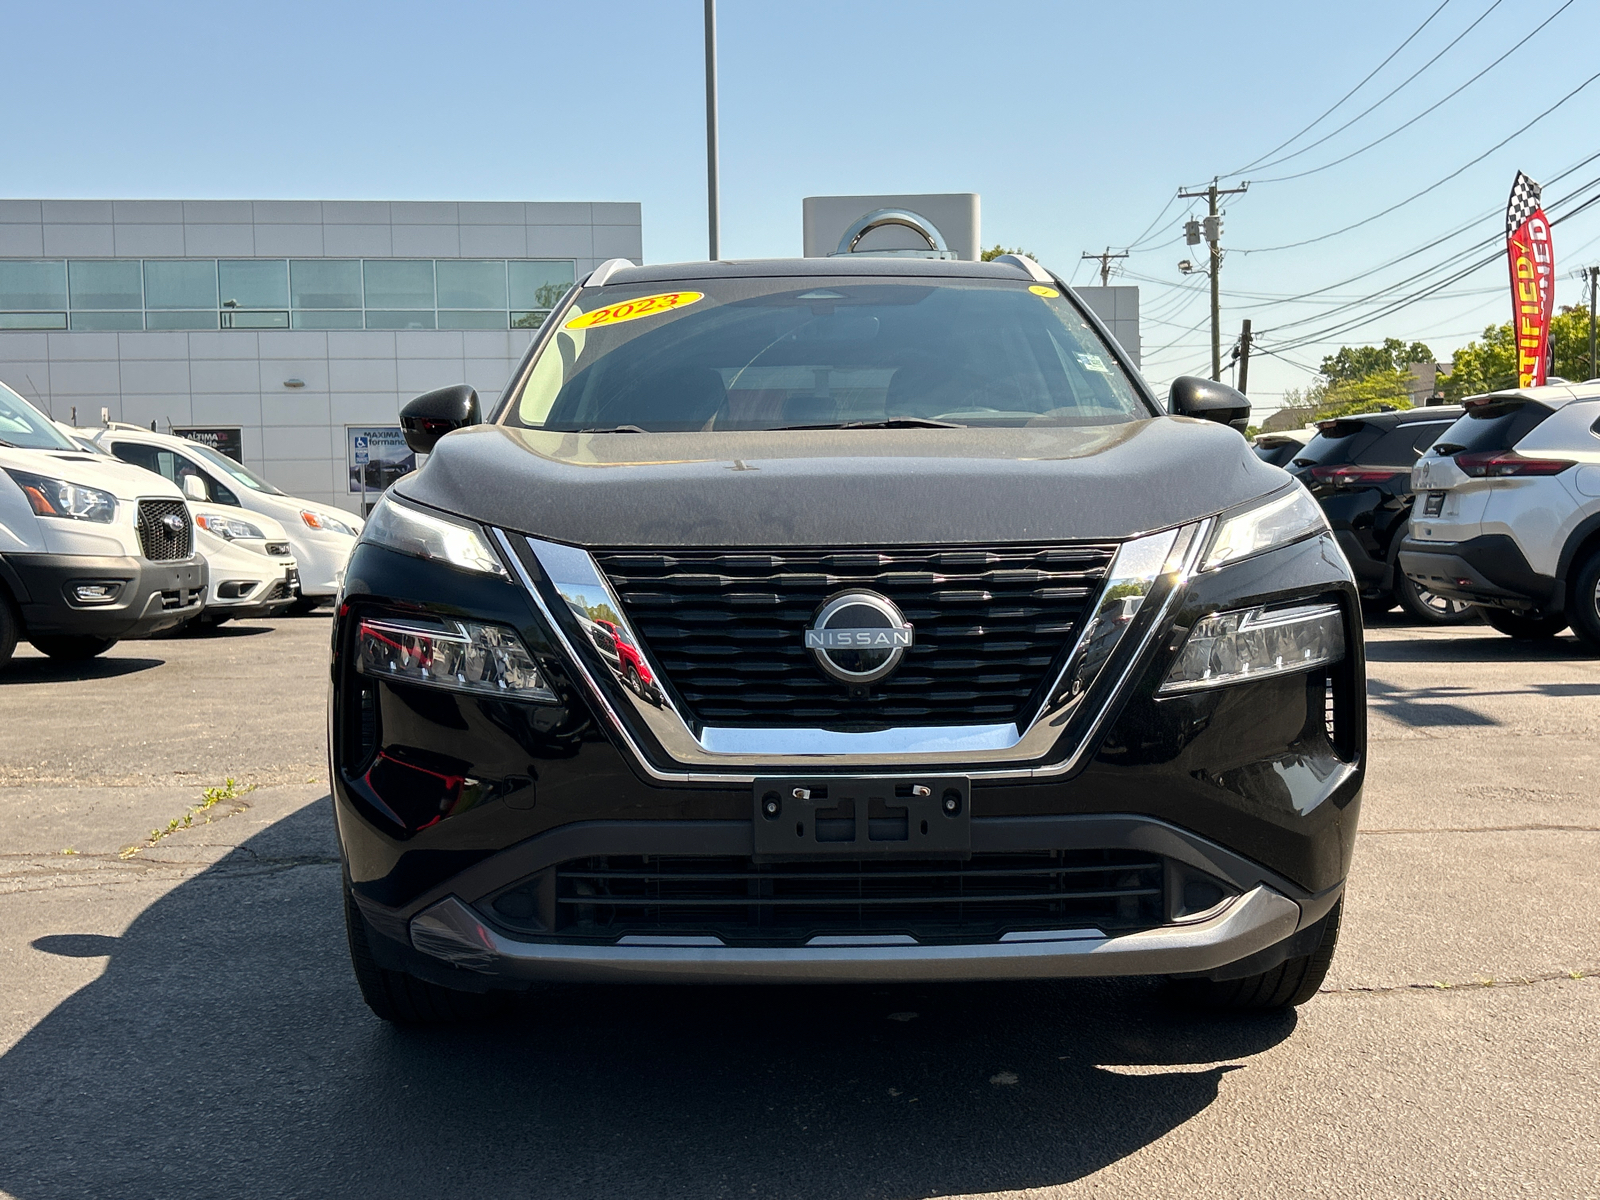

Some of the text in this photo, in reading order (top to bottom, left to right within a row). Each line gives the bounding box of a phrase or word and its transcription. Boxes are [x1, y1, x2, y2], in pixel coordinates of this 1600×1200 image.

[589, 294, 680, 325] 2023
[1516, 258, 1539, 388] RTIFIED
[809, 632, 909, 645] NISSAN
